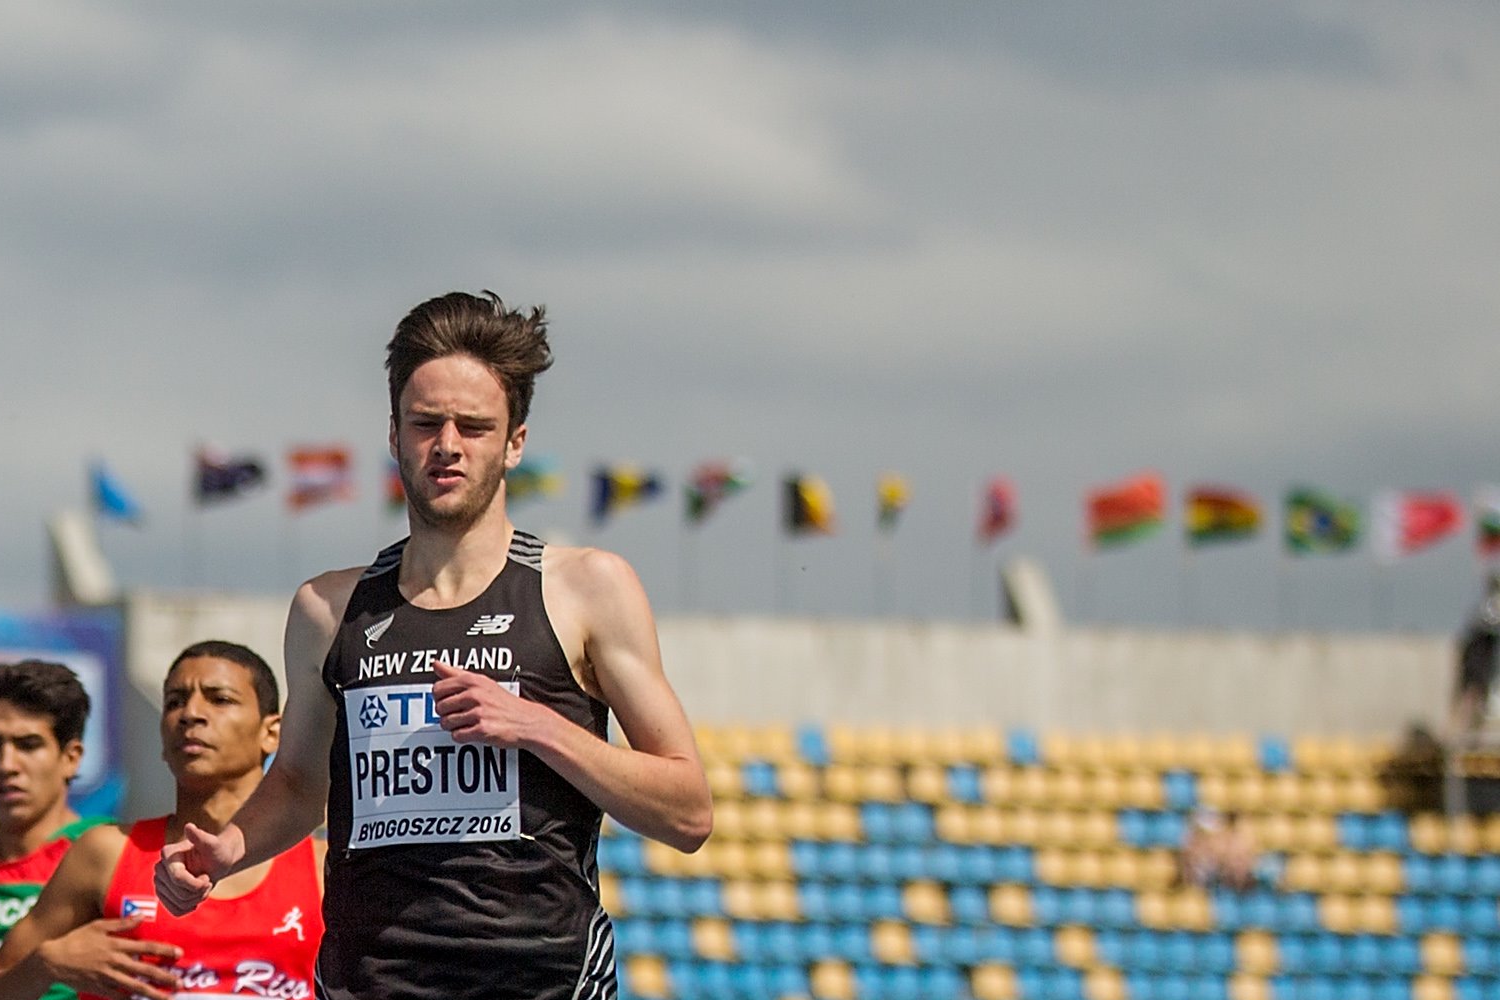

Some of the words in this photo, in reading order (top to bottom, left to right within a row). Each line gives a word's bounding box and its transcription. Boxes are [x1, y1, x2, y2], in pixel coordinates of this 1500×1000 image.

[358, 652, 407, 680] NEW
[411, 647, 513, 674] ZEALAND
[356, 745, 507, 800] PRESTON
[358, 816, 464, 841] BYDGOSZCZ
[467, 815, 512, 834] 2016
[234, 960, 311, 1000] Rico
